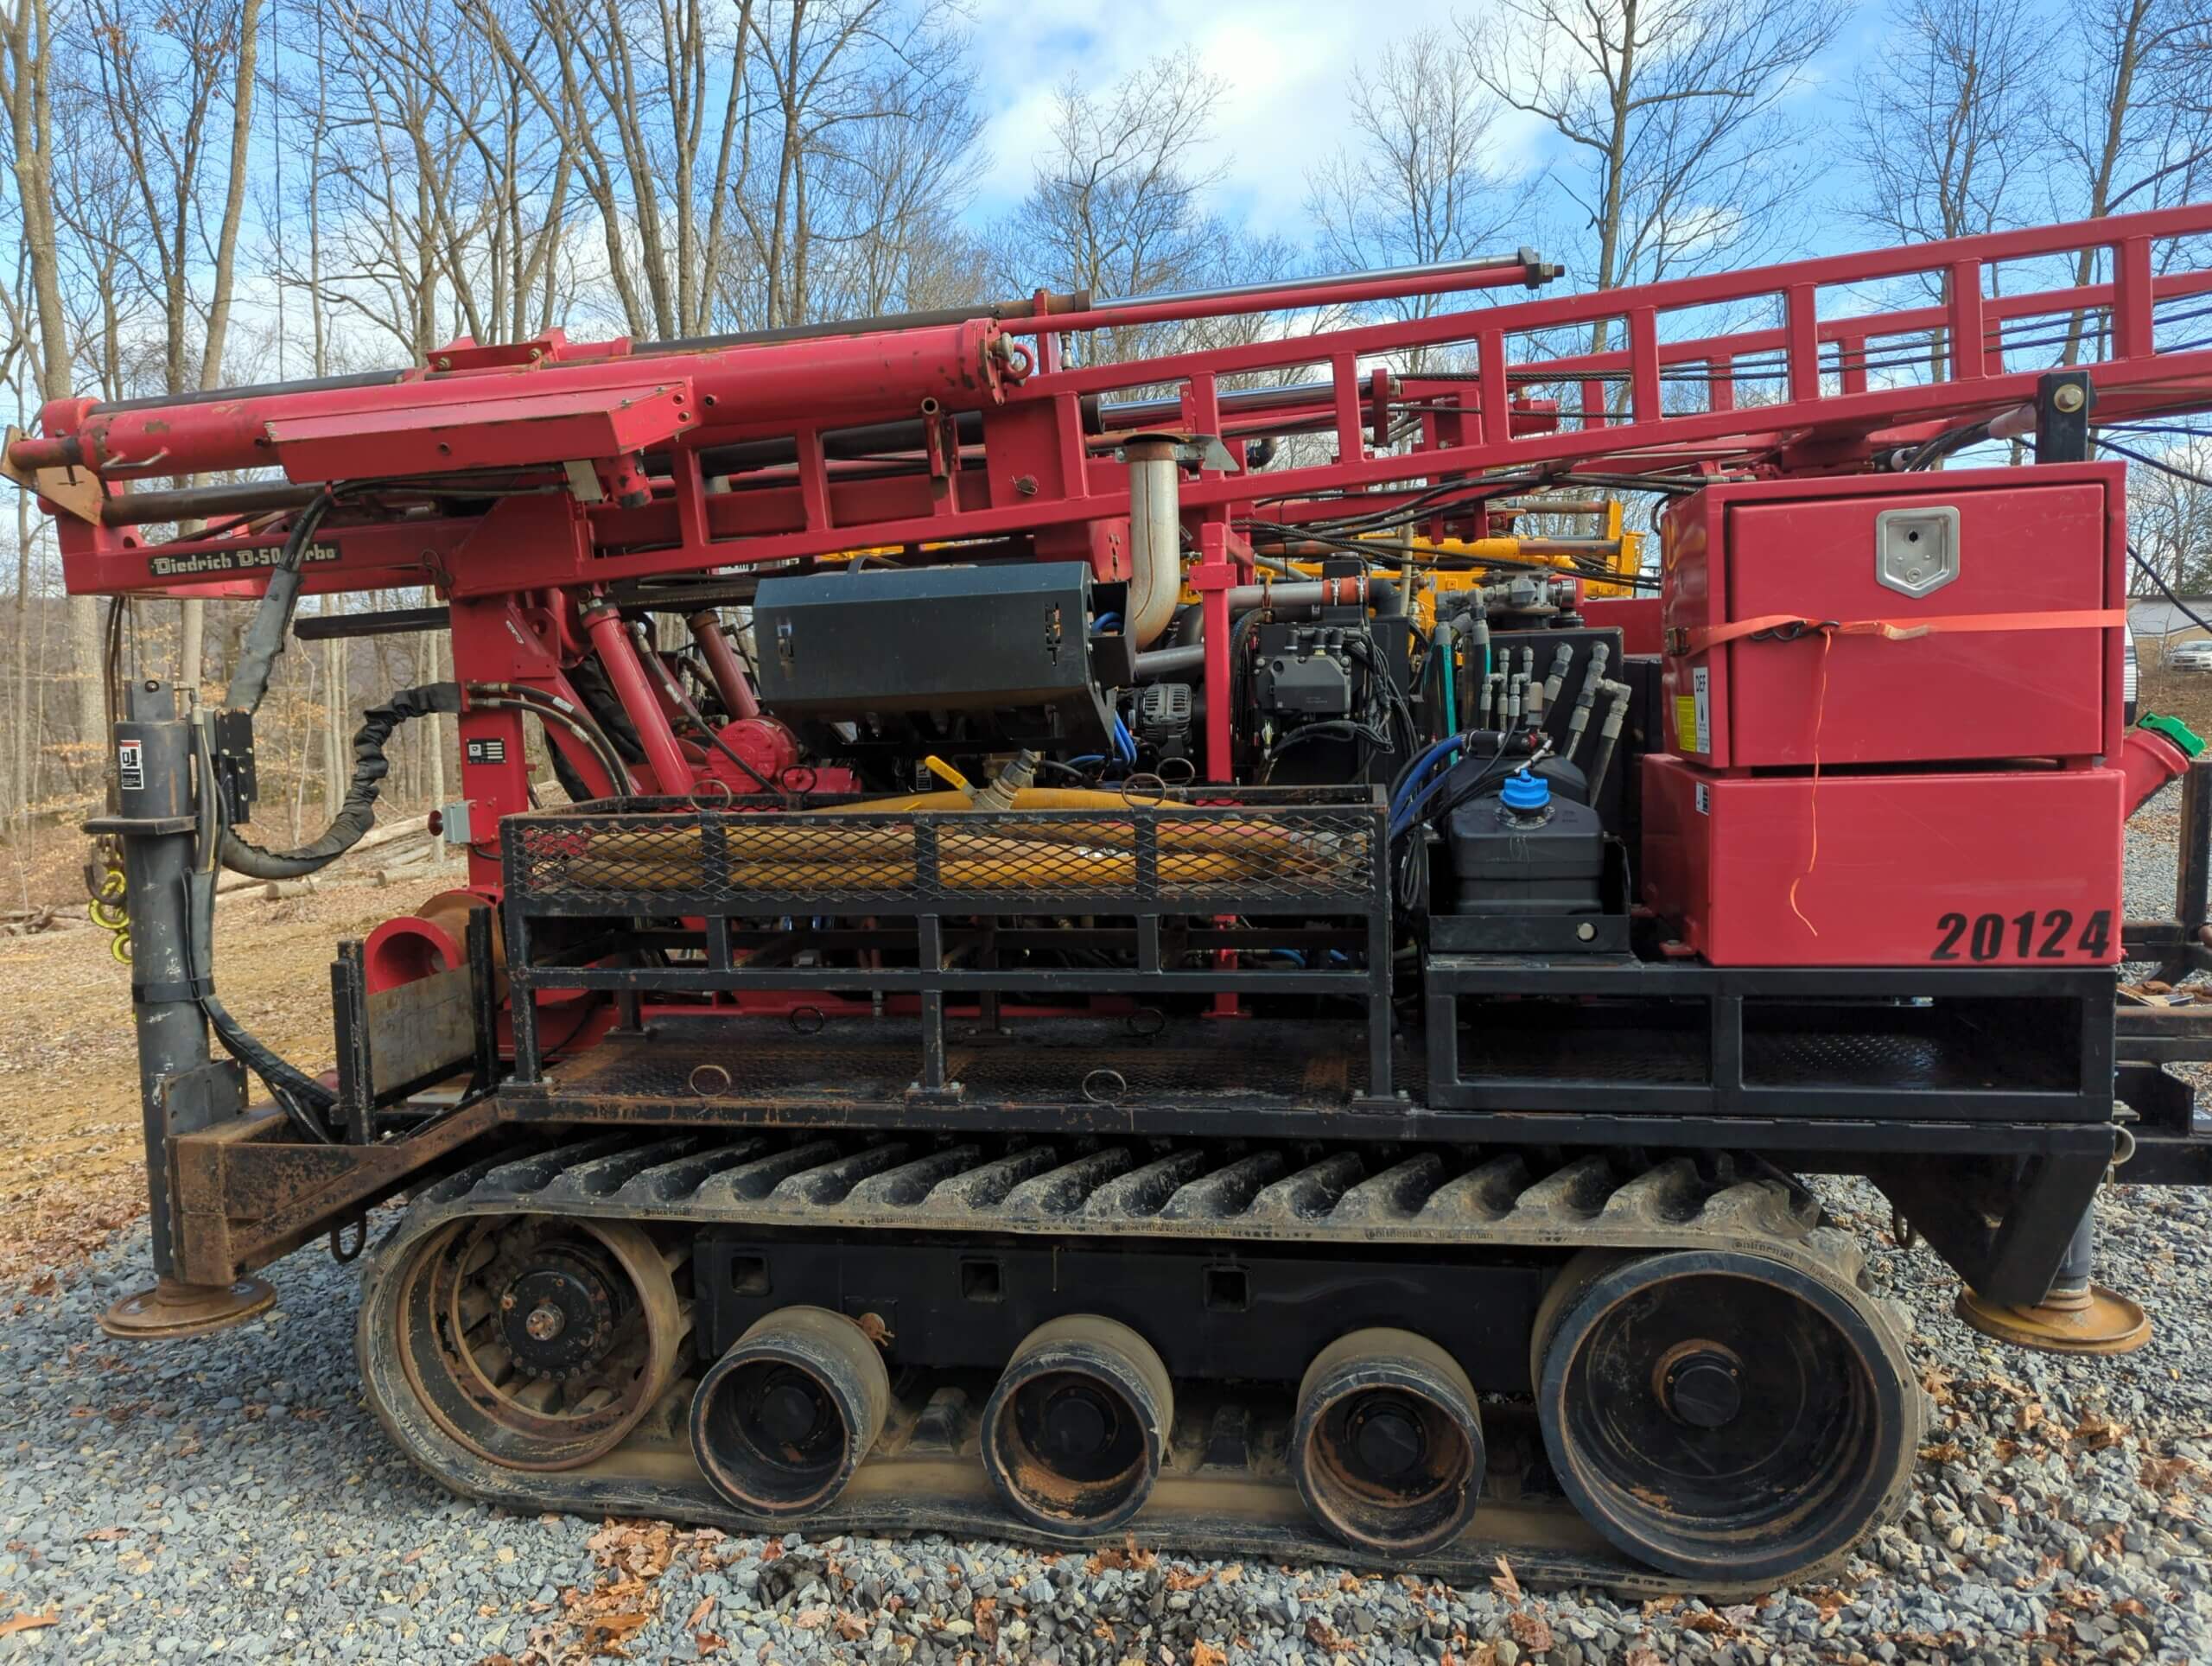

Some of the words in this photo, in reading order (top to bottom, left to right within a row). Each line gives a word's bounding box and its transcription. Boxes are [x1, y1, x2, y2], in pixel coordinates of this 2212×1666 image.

[154, 552, 232, 575] Diedrich
[1695, 674, 1707, 692] DEF
[1929, 908, 2112, 962] 20124
